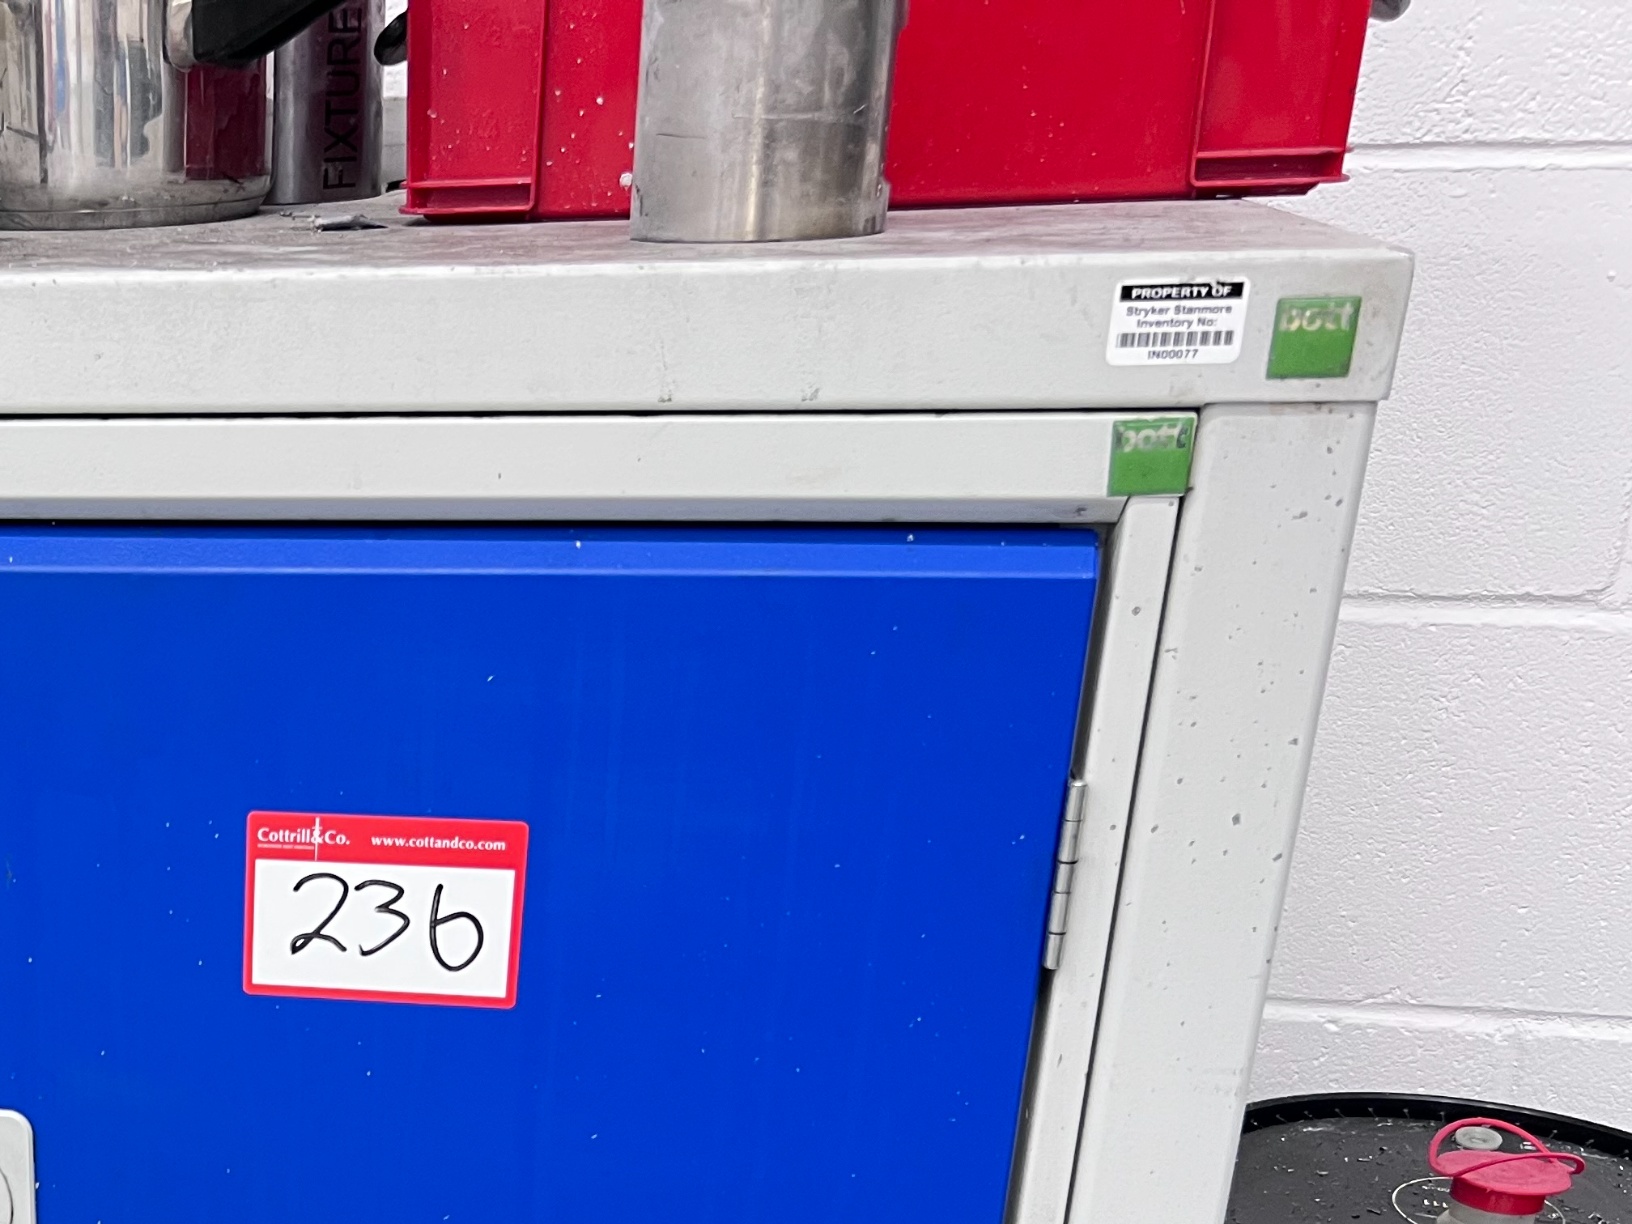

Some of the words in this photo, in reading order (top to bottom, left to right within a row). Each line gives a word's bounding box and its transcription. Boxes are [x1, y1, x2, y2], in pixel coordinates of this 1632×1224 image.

[322, 7, 362, 190] FIXTURE
[1131, 286, 1208, 299] PROPERTY
[1211, 285, 1232, 297] OF
[1126, 306, 1170, 318] Stryker
[1174, 305, 1232, 315] Stanmore
[1137, 318, 1193, 329] Inventory
[1197, 317, 1217, 327] No:
[1148, 349, 1199, 360] IN00077
[257, 826, 350, 845] Cottrill&Co.
[371, 835, 506, 851] www.cottandco.com
[290, 872, 484, 972] 236
